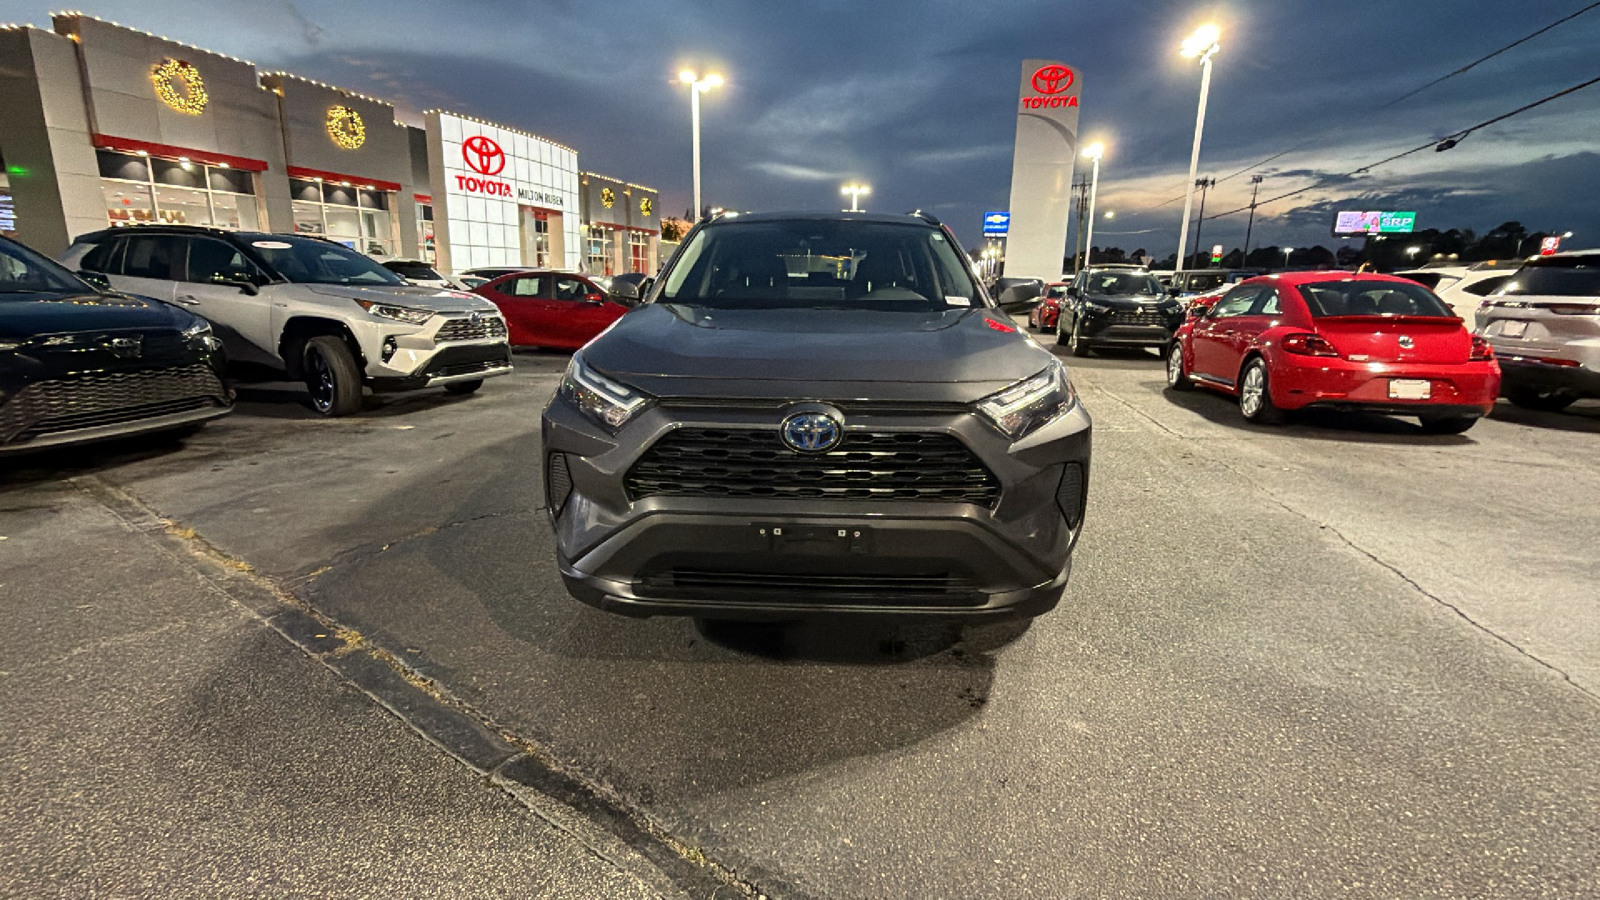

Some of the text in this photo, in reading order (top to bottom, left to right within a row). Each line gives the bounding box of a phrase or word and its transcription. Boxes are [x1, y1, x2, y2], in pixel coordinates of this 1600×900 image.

[1022, 96, 1078, 108] TOYOTA
[455, 175, 513, 198] TOYOTA
[518, 188, 564, 207] MILTON RUBEN
[1381, 217, 1413, 227] SRP
